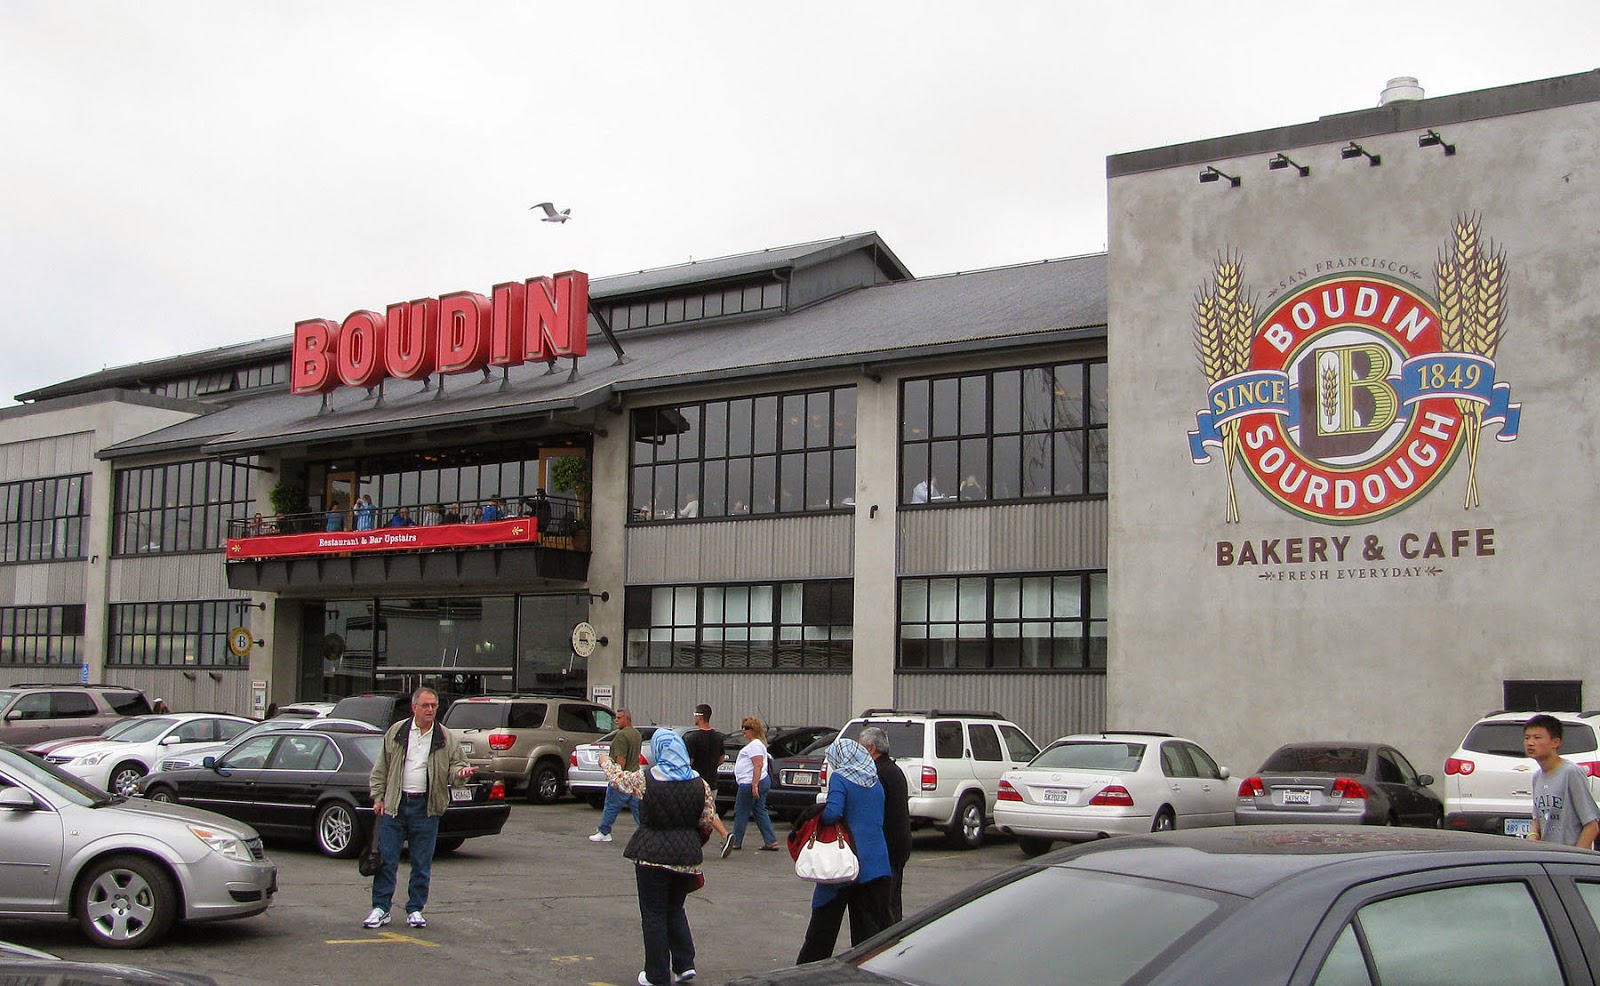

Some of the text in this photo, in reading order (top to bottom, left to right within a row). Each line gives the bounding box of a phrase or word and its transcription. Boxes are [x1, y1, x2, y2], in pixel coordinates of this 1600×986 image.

[1279, 256, 1409, 290] SAN FRANCISCO
[290, 269, 589, 395] BOUDIN
[1263, 286, 1430, 353] BOUDIN
[1213, 364, 1482, 416] SINCE 1849
[1245, 411, 1455, 510] SOURDOUGH
[319, 533, 417, 547] Restaurant & Bar Upstairs
[1216, 528, 1495, 567] BAKERY & CAFE
[1278, 566, 1422, 581] FRESH EVERYDAY
